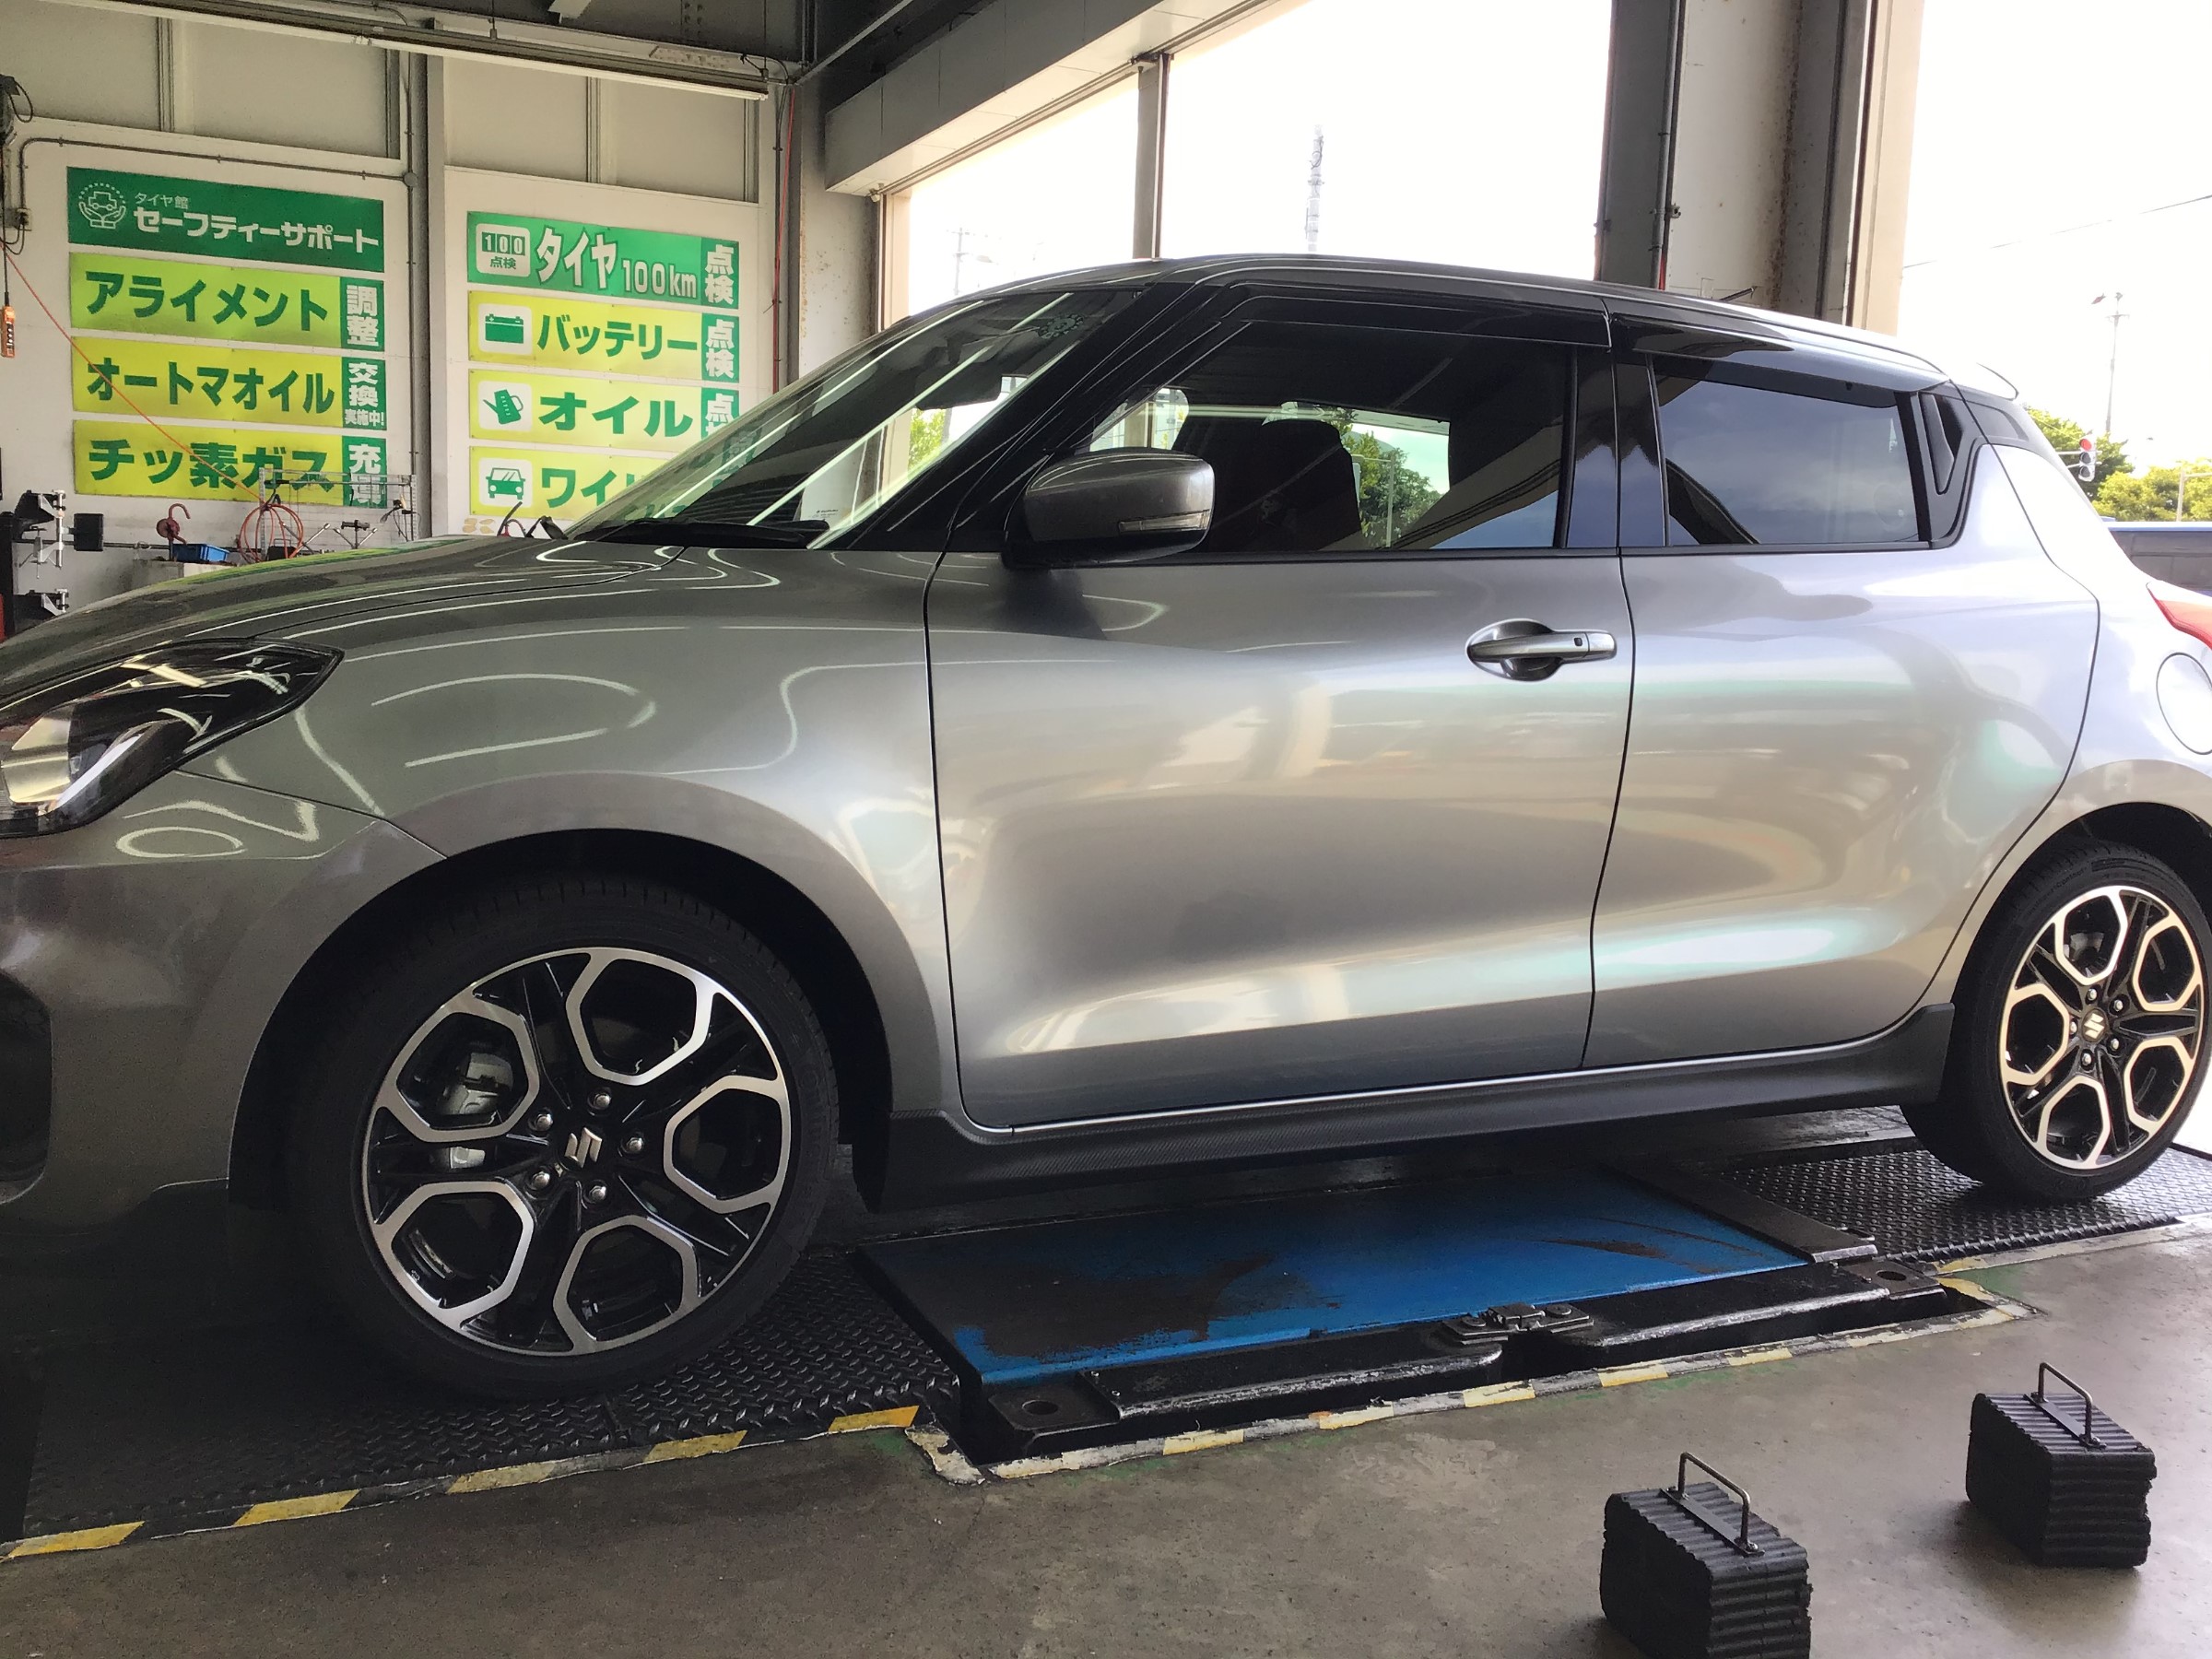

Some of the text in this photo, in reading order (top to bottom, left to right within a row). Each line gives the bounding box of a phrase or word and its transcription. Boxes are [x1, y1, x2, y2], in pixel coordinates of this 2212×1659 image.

[135, 192, 189, 210] タイヤ館
[133, 206, 379, 253] セーフティーサポート
[484, 233, 525, 255] 100
[489, 255, 517, 270] 点検
[535, 226, 698, 300] タイヤ 100km
[703, 244, 735, 305] 点検
[86, 271, 328, 332] アライメント
[346, 285, 379, 347] 調整
[537, 314, 698, 360] バッテリー
[704, 319, 735, 379] 点検
[88, 357, 335, 414] オートマオイル
[348, 362, 379, 407] 交換
[539, 392, 693, 438] オイル
[705, 393, 735, 436] 点
[88, 439, 335, 492] チッ素ガス
[541, 468, 636, 508] ワイ
